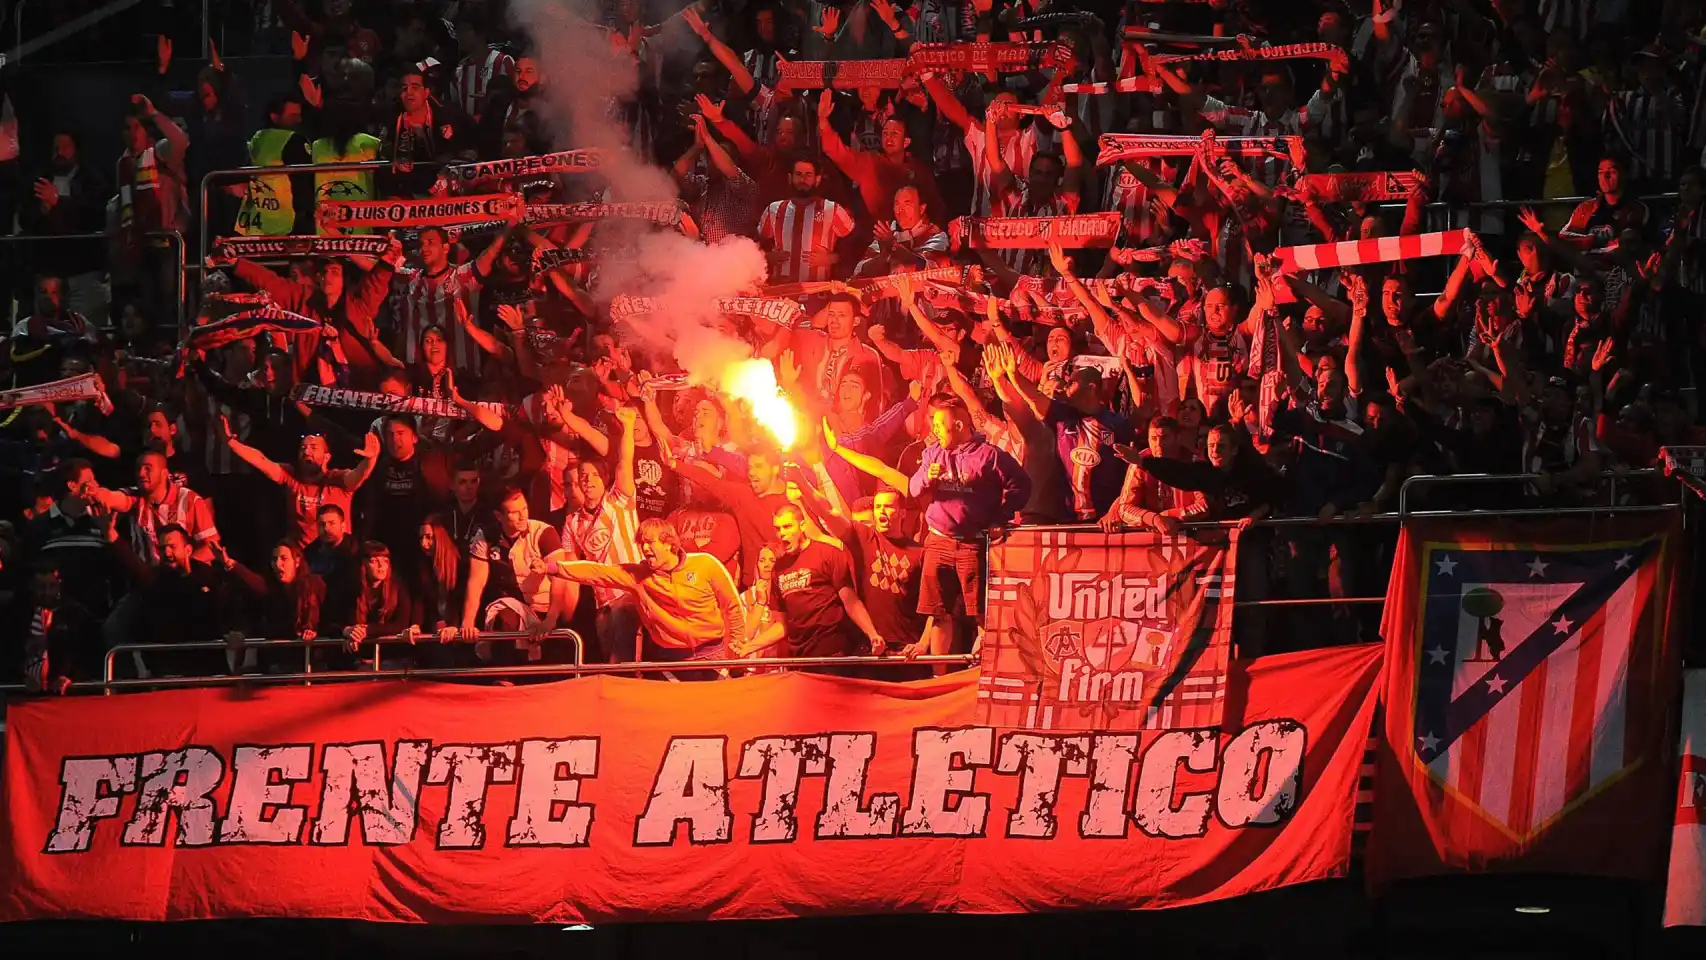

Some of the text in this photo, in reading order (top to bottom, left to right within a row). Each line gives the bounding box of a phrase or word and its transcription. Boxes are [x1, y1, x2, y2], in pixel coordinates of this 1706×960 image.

[462, 152, 600, 181] CAMPEONES
[355, 206, 386, 221] LUIS
[1058, 219, 1109, 237] MADRID
[302, 385, 383, 410] FRENTE
[1074, 450, 1095, 464] KIA
[588, 531, 610, 549] KIA
[1048, 572, 1167, 620] United
[42, 717, 1308, 853] FRENTE ATLETICO
